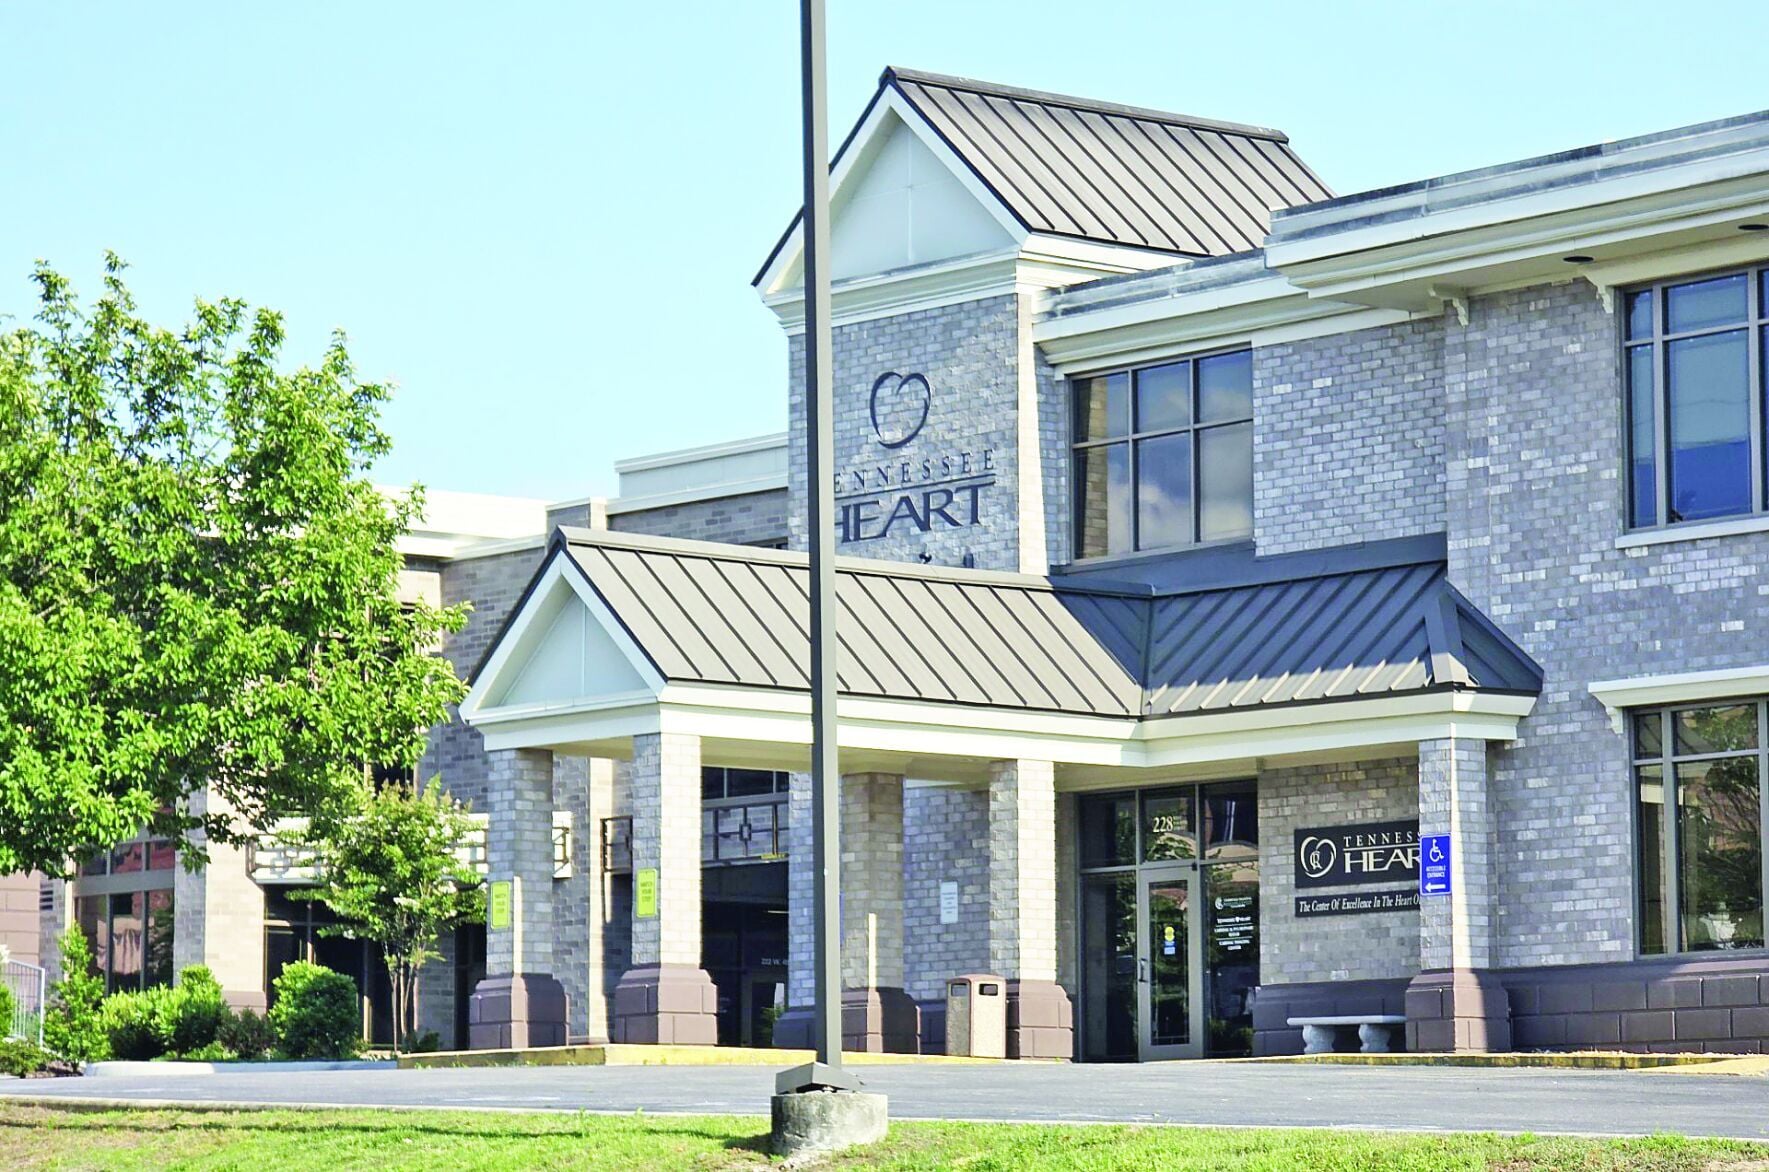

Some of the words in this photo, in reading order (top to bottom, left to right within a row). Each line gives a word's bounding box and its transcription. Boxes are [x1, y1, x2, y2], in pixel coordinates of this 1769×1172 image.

[834, 448, 995, 494] ENNESSEE
[1152, 815, 1173, 833] 228
[1299, 901, 1311, 913] The
[1311, 900, 1330, 912] Center
[1331, 898, 1340, 910] Of
[1341, 897, 1372, 910] Excellence
[1373, 895, 1381, 908] In
[1382, 894, 1394, 907] The
[1394, 893, 1413, 907] Heart
